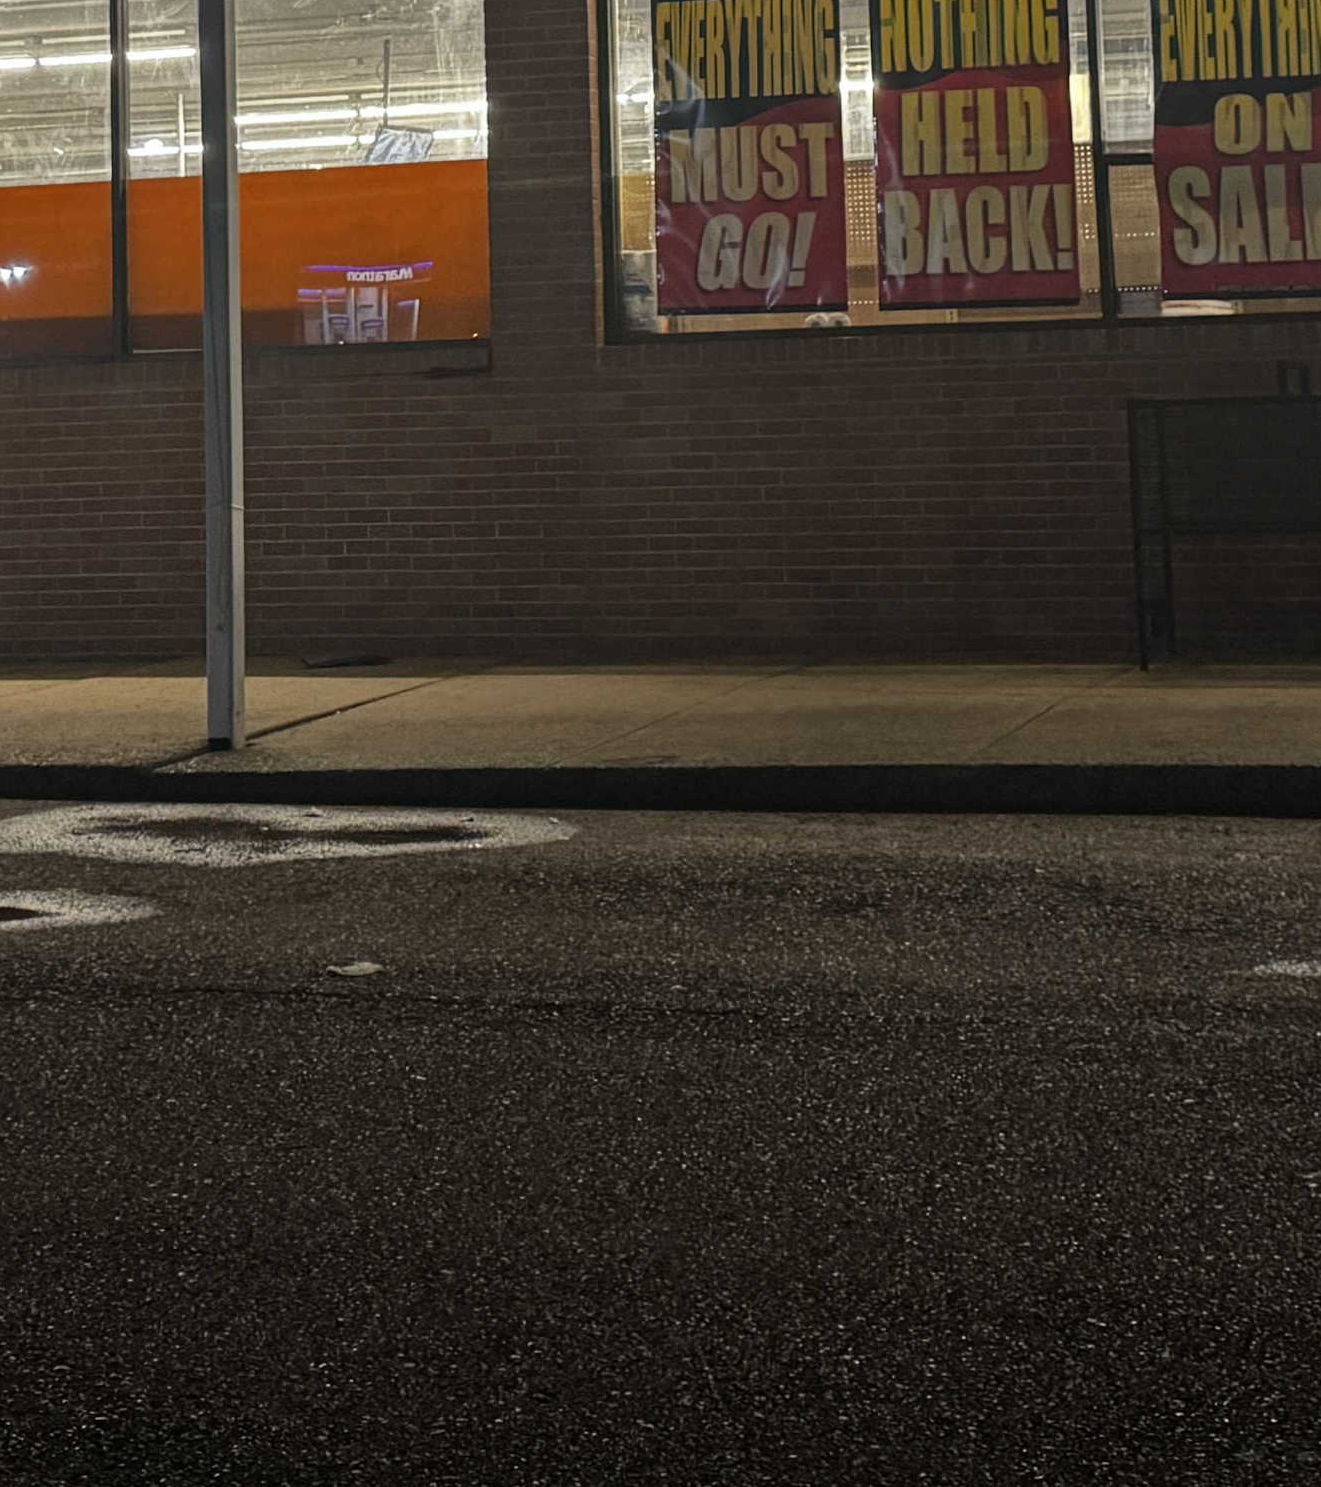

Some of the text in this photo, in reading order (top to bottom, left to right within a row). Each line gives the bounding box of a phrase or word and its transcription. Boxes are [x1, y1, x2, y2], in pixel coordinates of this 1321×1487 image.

[670, 122, 834, 204] MUST
[900, 86, 1049, 176] HELD
[1213, 92, 1313, 155] ON
[697, 211, 816, 291] GO!
[883, 184, 1075, 276] BACK!
